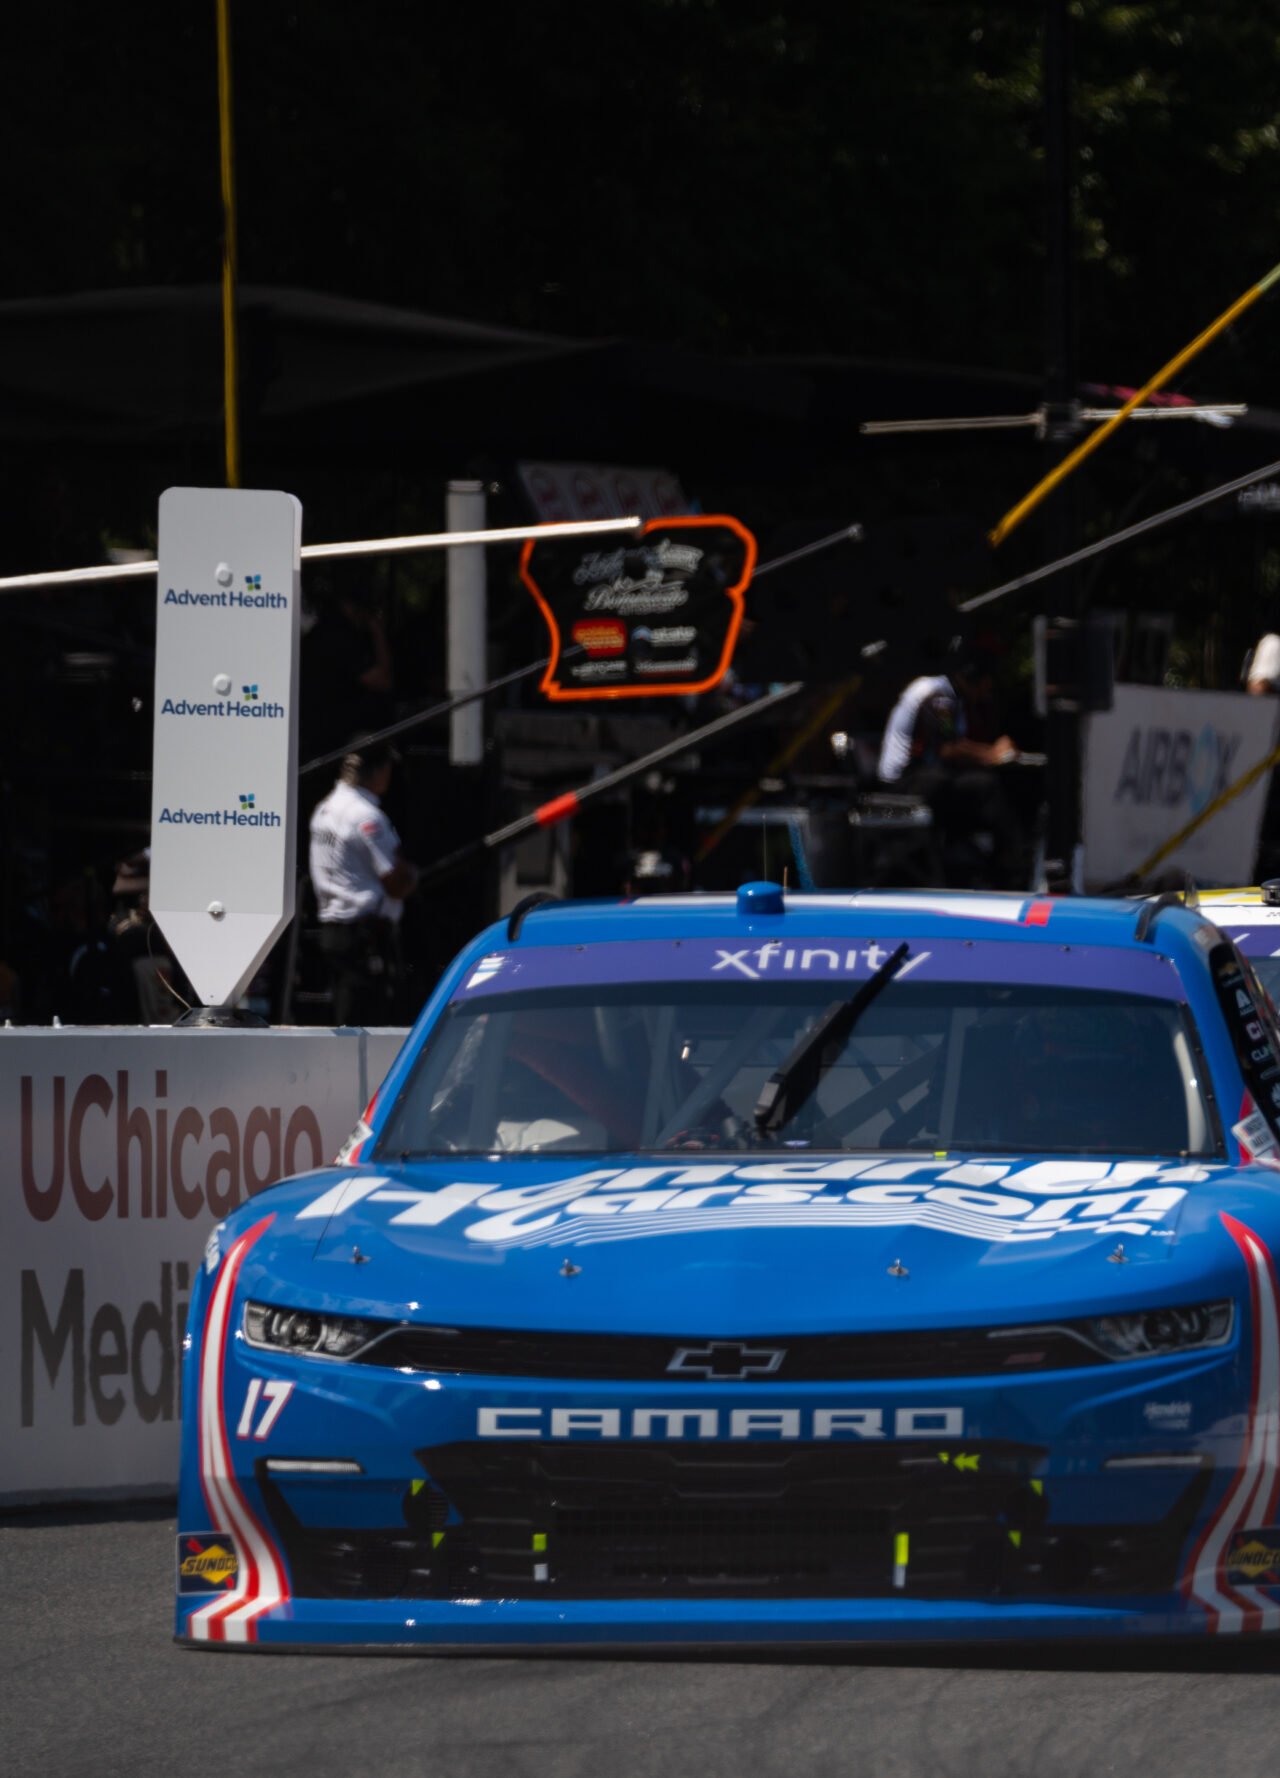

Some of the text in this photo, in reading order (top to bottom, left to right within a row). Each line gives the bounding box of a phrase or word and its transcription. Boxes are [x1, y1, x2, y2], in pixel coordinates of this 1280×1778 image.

[164, 588, 287, 609] AdventHealth
[161, 698, 284, 718] AdventHealth
[158, 808, 281, 827] AdventHealth
[713, 943, 931, 980] xfinity
[20, 1070, 324, 1222] UChicago
[236, 1377, 296, 1441] 17
[476, 1406, 965, 1439] CAMARO
